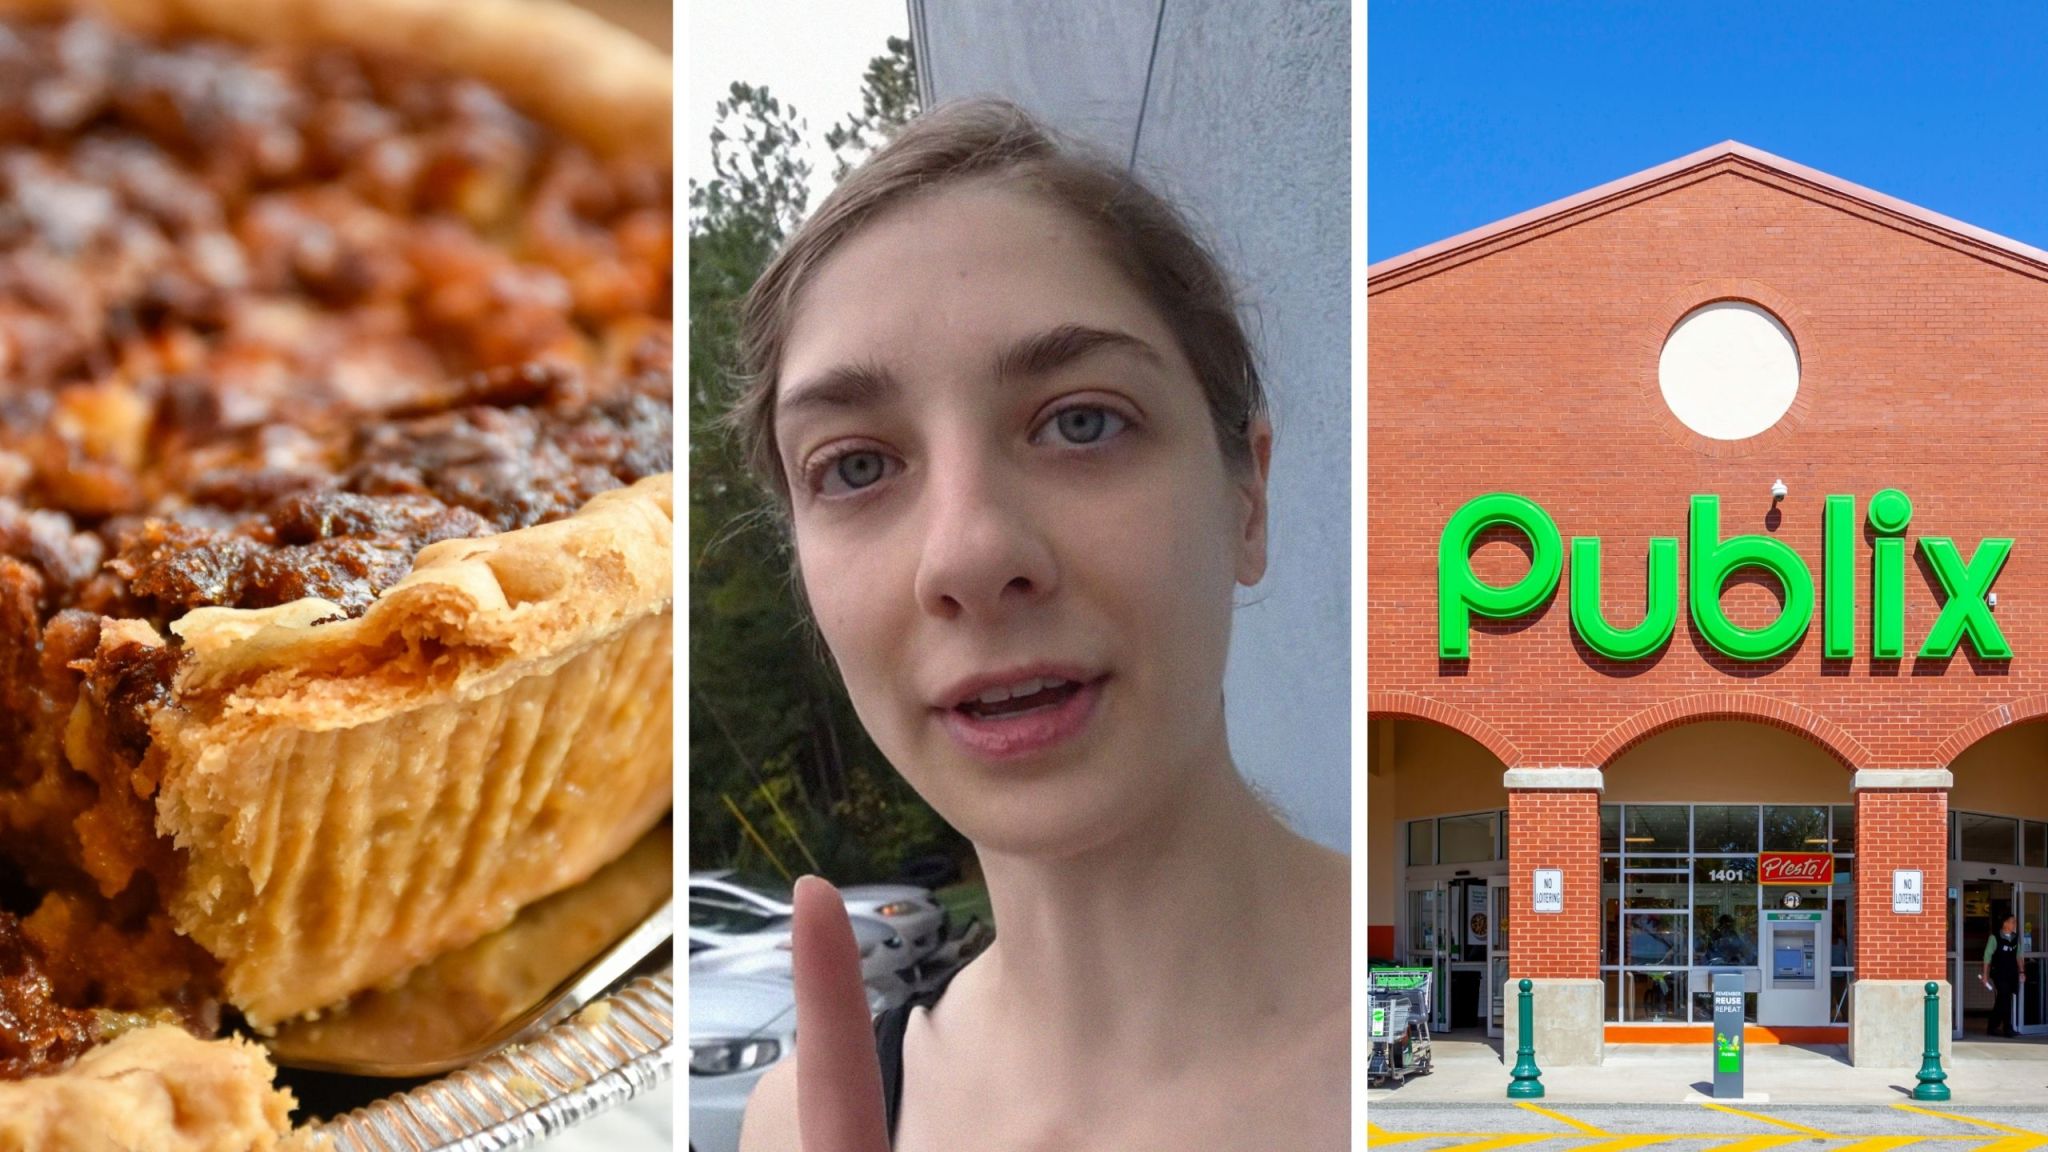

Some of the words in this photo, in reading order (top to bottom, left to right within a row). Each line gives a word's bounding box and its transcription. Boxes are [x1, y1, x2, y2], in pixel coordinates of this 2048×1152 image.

[1438, 488, 2015, 661] Publix
[1762, 857, 1830, 879] Presto!
[1709, 869, 1744, 881] 1401
[1543, 878, 1552, 888] NO
[1904, 878, 1912, 889] NO
[1715, 997, 1742, 1005] REUSE
[1715, 1005, 1741, 1013] REPEAT
